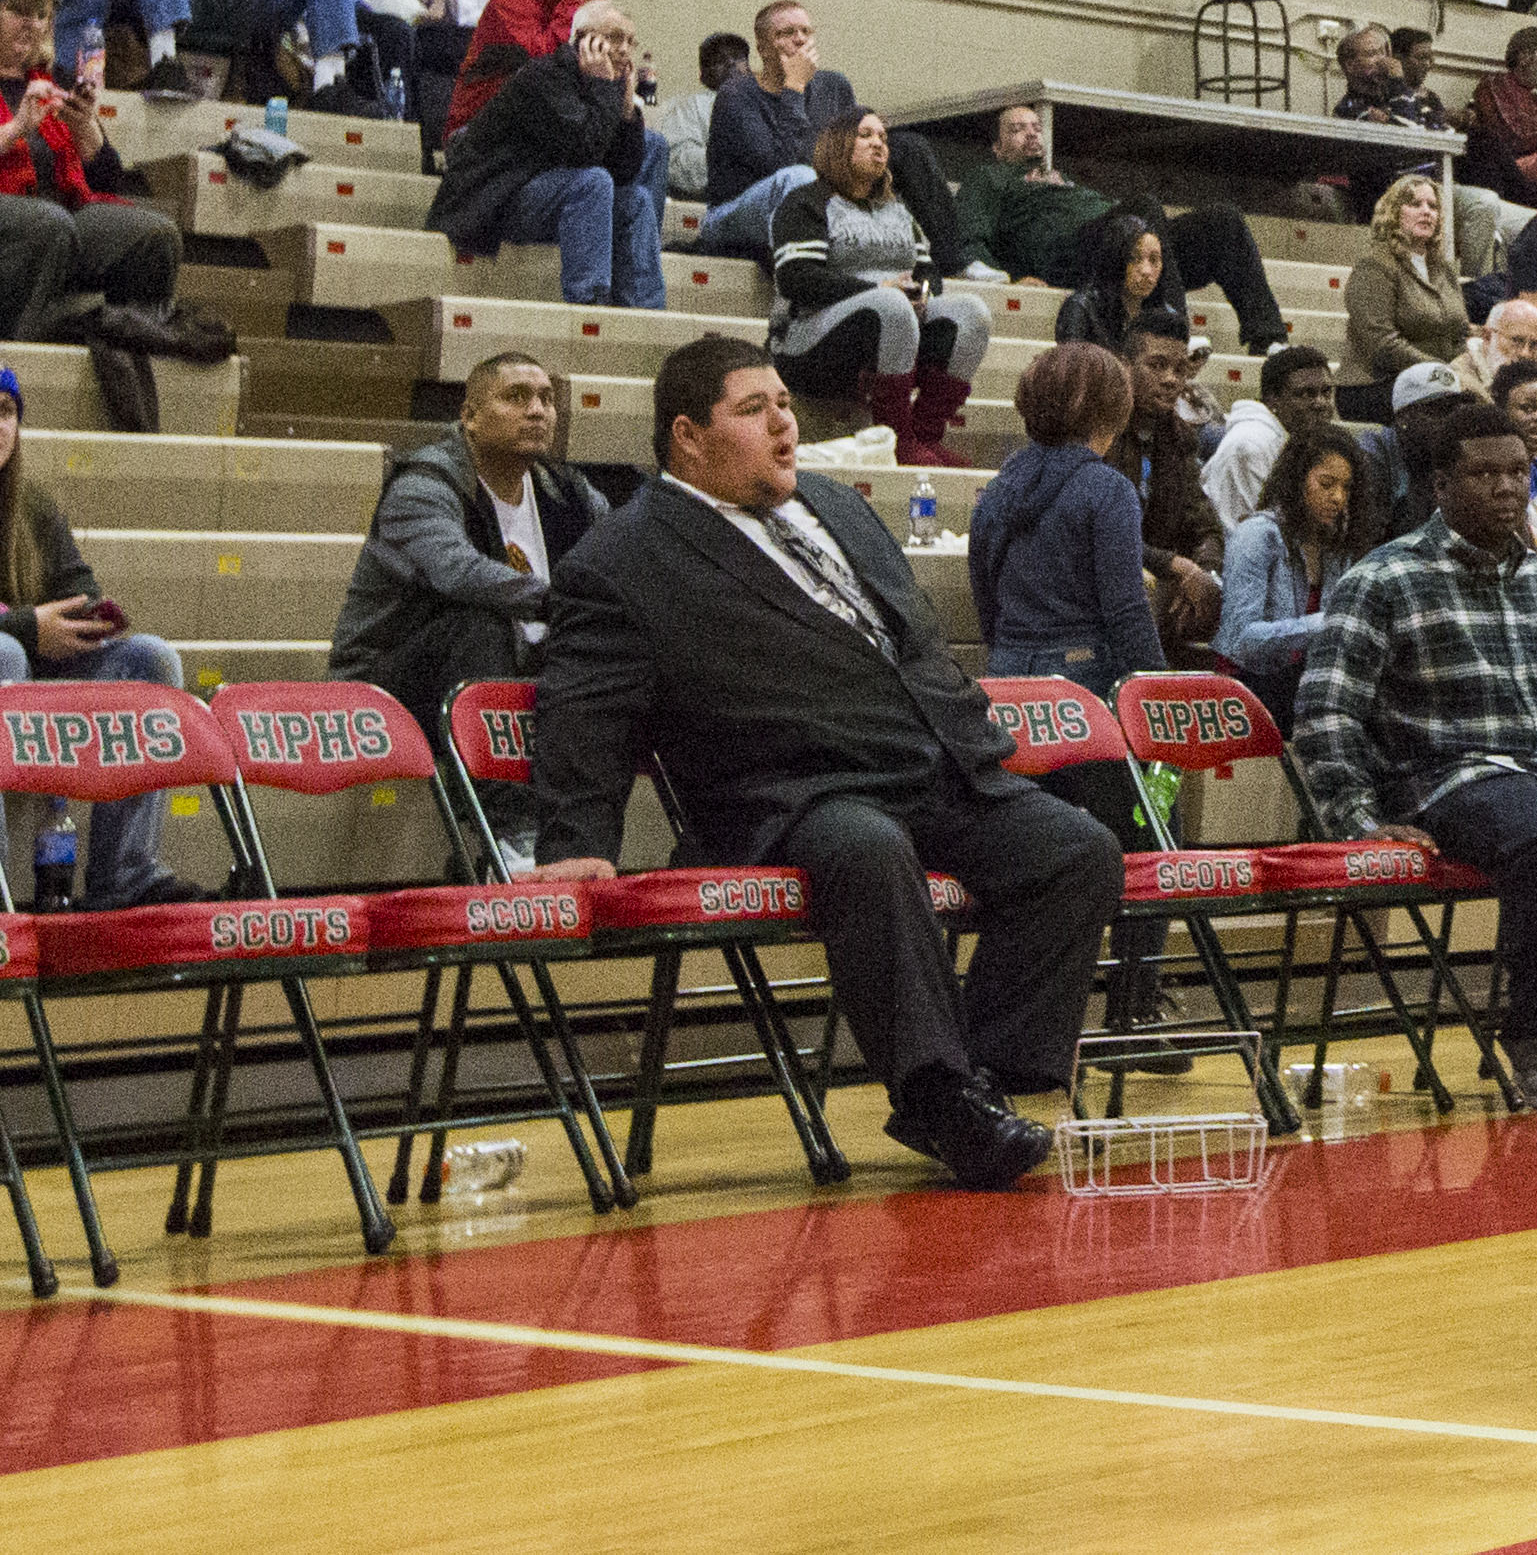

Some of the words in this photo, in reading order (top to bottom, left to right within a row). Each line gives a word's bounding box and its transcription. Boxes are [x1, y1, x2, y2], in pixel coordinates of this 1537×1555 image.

[3, 708, 187, 768] HPHS
[236, 707, 392, 763] HPHS
[480, 709, 536, 760] HP
[988, 699, 1091, 745] PHS
[1141, 698, 1252, 744] HPHS
[1157, 859, 1254, 893] SCOTS
[1344, 848, 1429, 881] SCOTS
[466, 895, 580, 934] SCOTS
[698, 876, 804, 914] SCOTS
[211, 907, 351, 949] SCOTS
